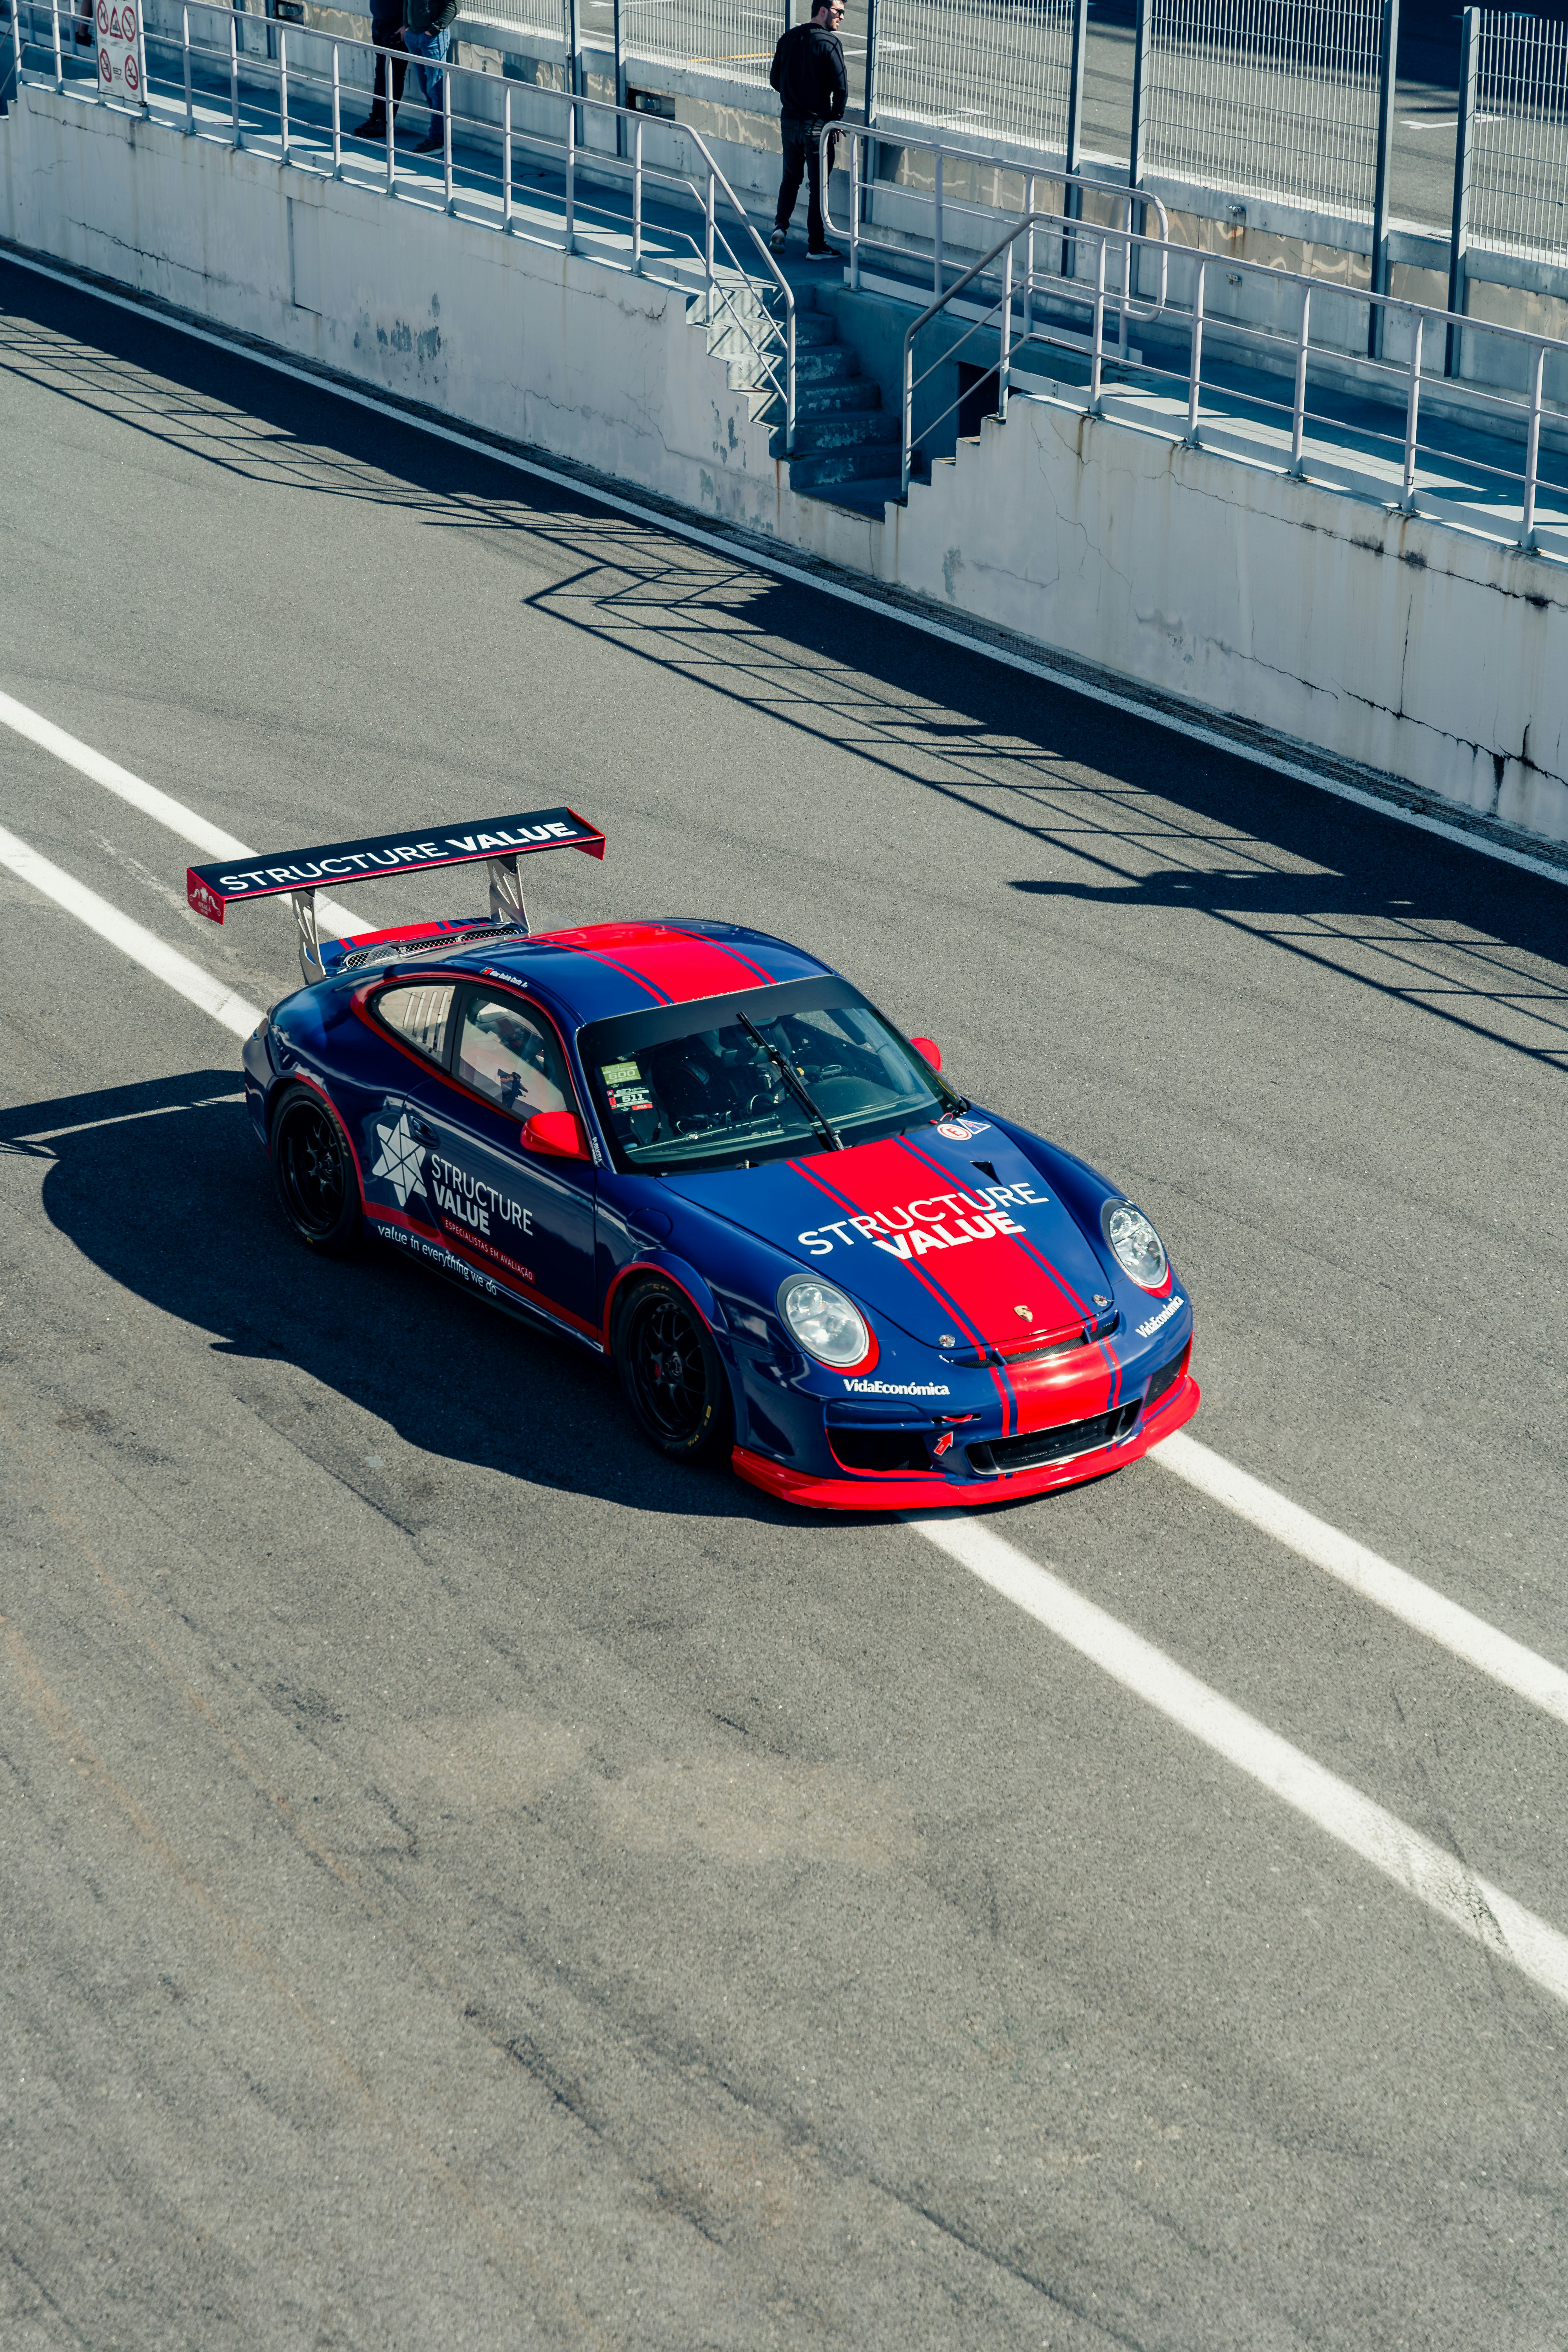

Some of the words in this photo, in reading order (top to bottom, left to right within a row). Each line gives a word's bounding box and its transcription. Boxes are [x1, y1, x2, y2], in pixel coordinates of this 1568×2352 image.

[219, 842, 449, 890] STRUCTURE
[445, 822, 577, 851] VALUE
[608, 1069, 635, 1080] 600
[622, 1093, 644, 1103] 511
[946, 1128, 964, 1136] E
[431, 1154, 533, 1236] STRUCTURE
[432, 1180, 490, 1236] VALUE
[797, 1182, 1050, 1255] STRUCTURE
[377, 1225, 407, 1245] value
[410, 1235, 419, 1251] in
[422, 1244, 469, 1281] everything
[471, 1271, 483, 1287] we
[486, 1279, 497, 1296] do
[445, 1220, 488, 1252] ESPECIALISTAS
[490, 1247, 499, 1259] EM
[500, 1255, 533, 1280] AVALIAÇÃO
[871, 1210, 1027, 1260] VALUE
[1134, 1295, 1184, 1338] VidaEconómica
[843, 1378, 951, 1396] VidaEconómica
